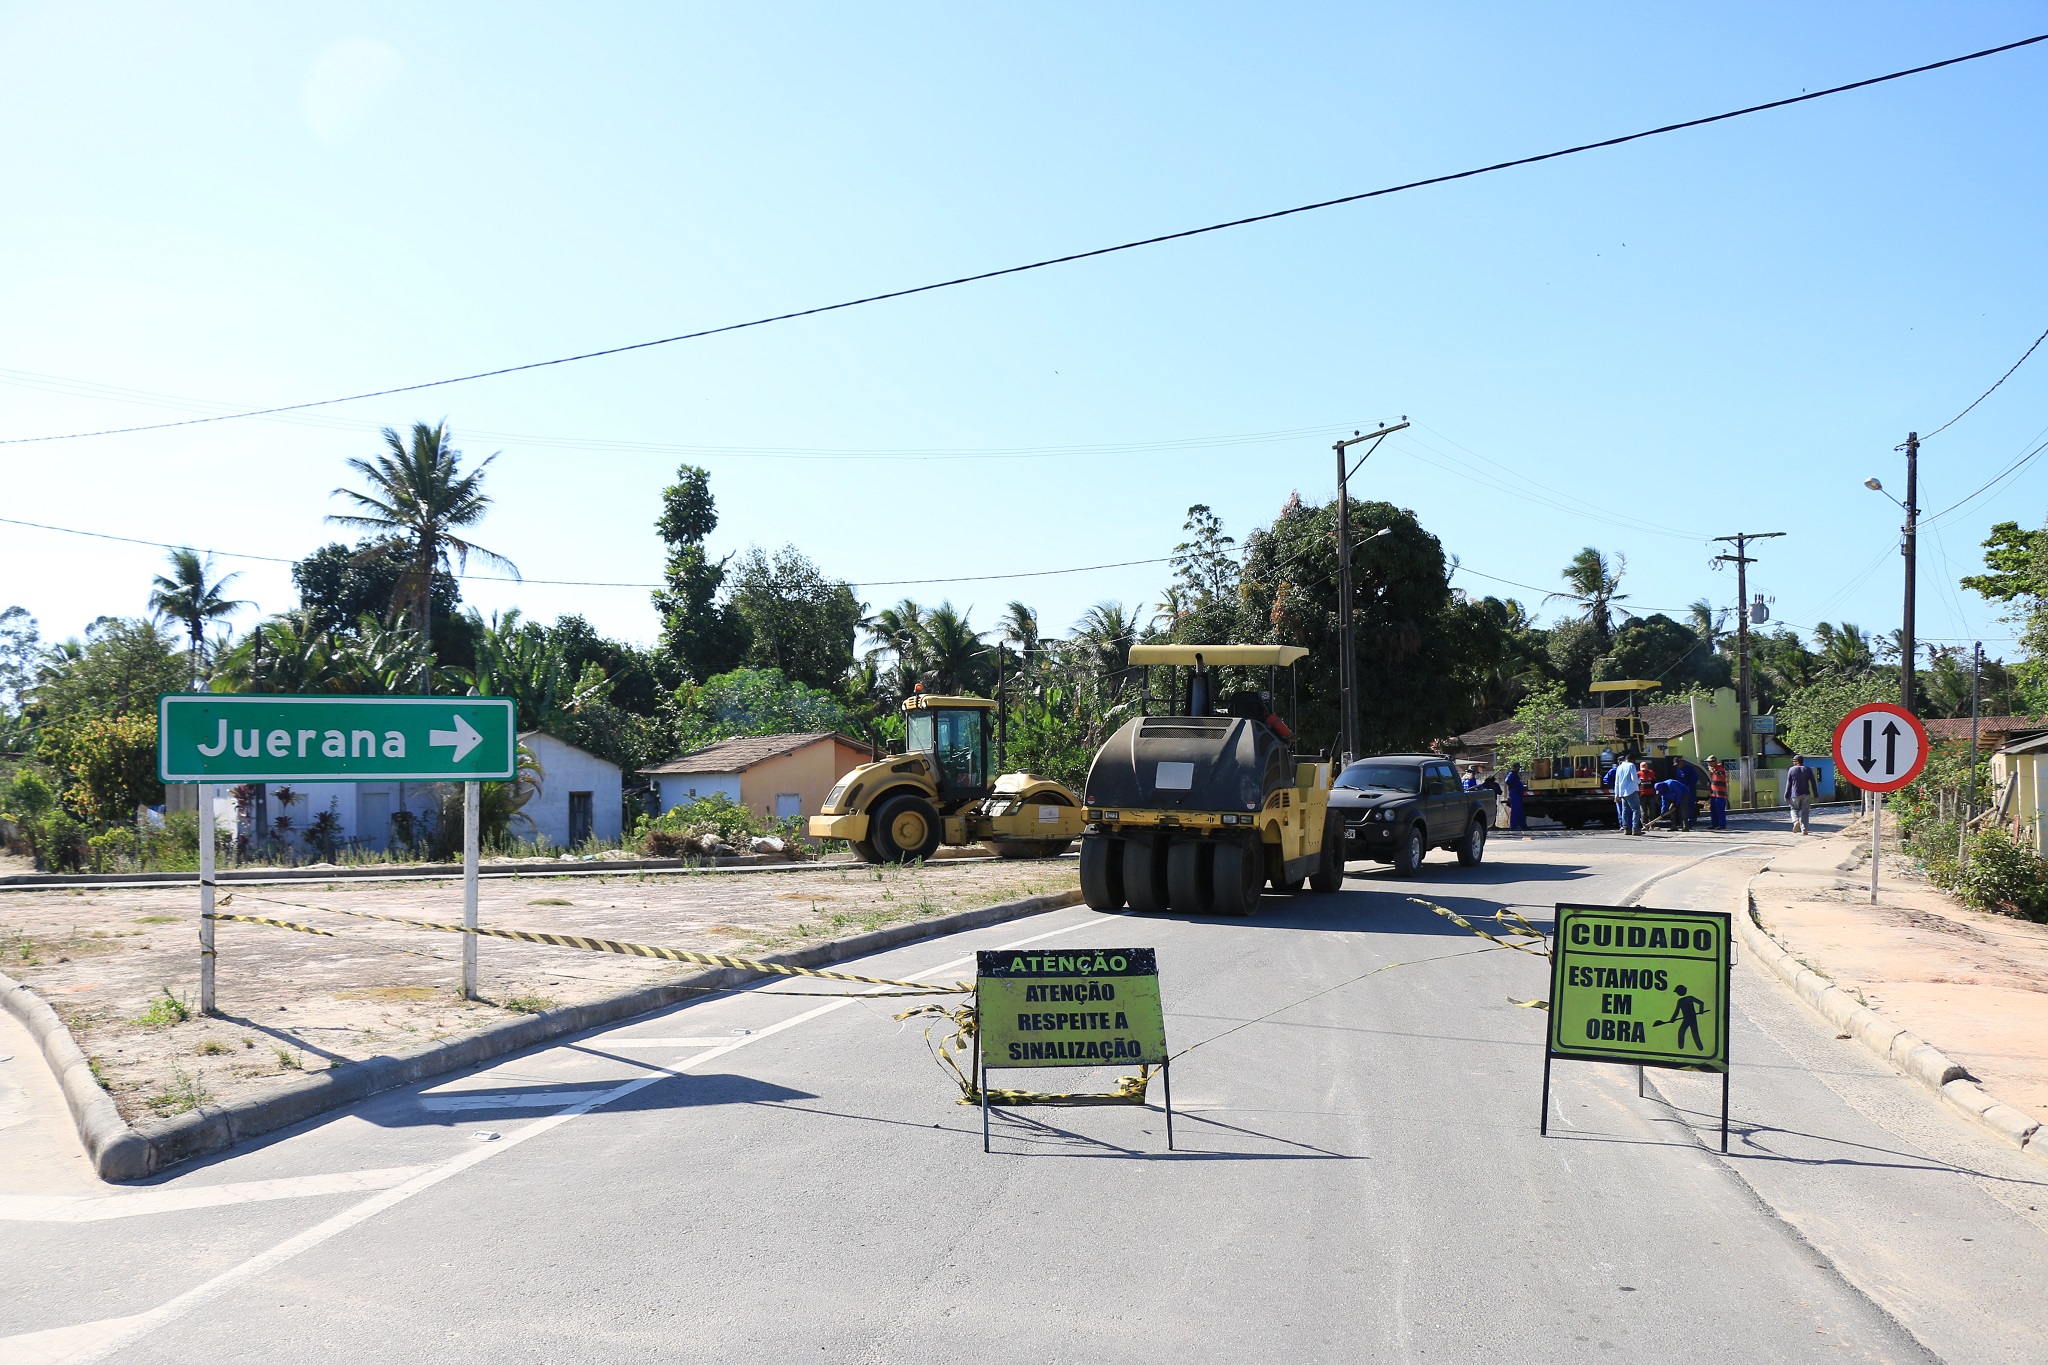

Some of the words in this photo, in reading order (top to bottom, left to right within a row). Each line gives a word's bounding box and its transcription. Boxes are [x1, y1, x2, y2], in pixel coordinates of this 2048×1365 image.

[197, 718, 406, 758] Juerana
[1571, 923, 1712, 951] CUIDADO
[1009, 951, 1127, 976] ATENÇÃO
[1568, 965, 1668, 991] ESTAMOS
[1025, 980, 1115, 1005] ATENÇÃO
[1601, 993, 1632, 1015] EM
[1017, 1012, 1110, 1031] RESPEITE
[1114, 1011, 1129, 1030] A
[1585, 1018, 1646, 1044] OBRA
[1008, 1037, 1142, 1063] SINALIZAÇÃO
